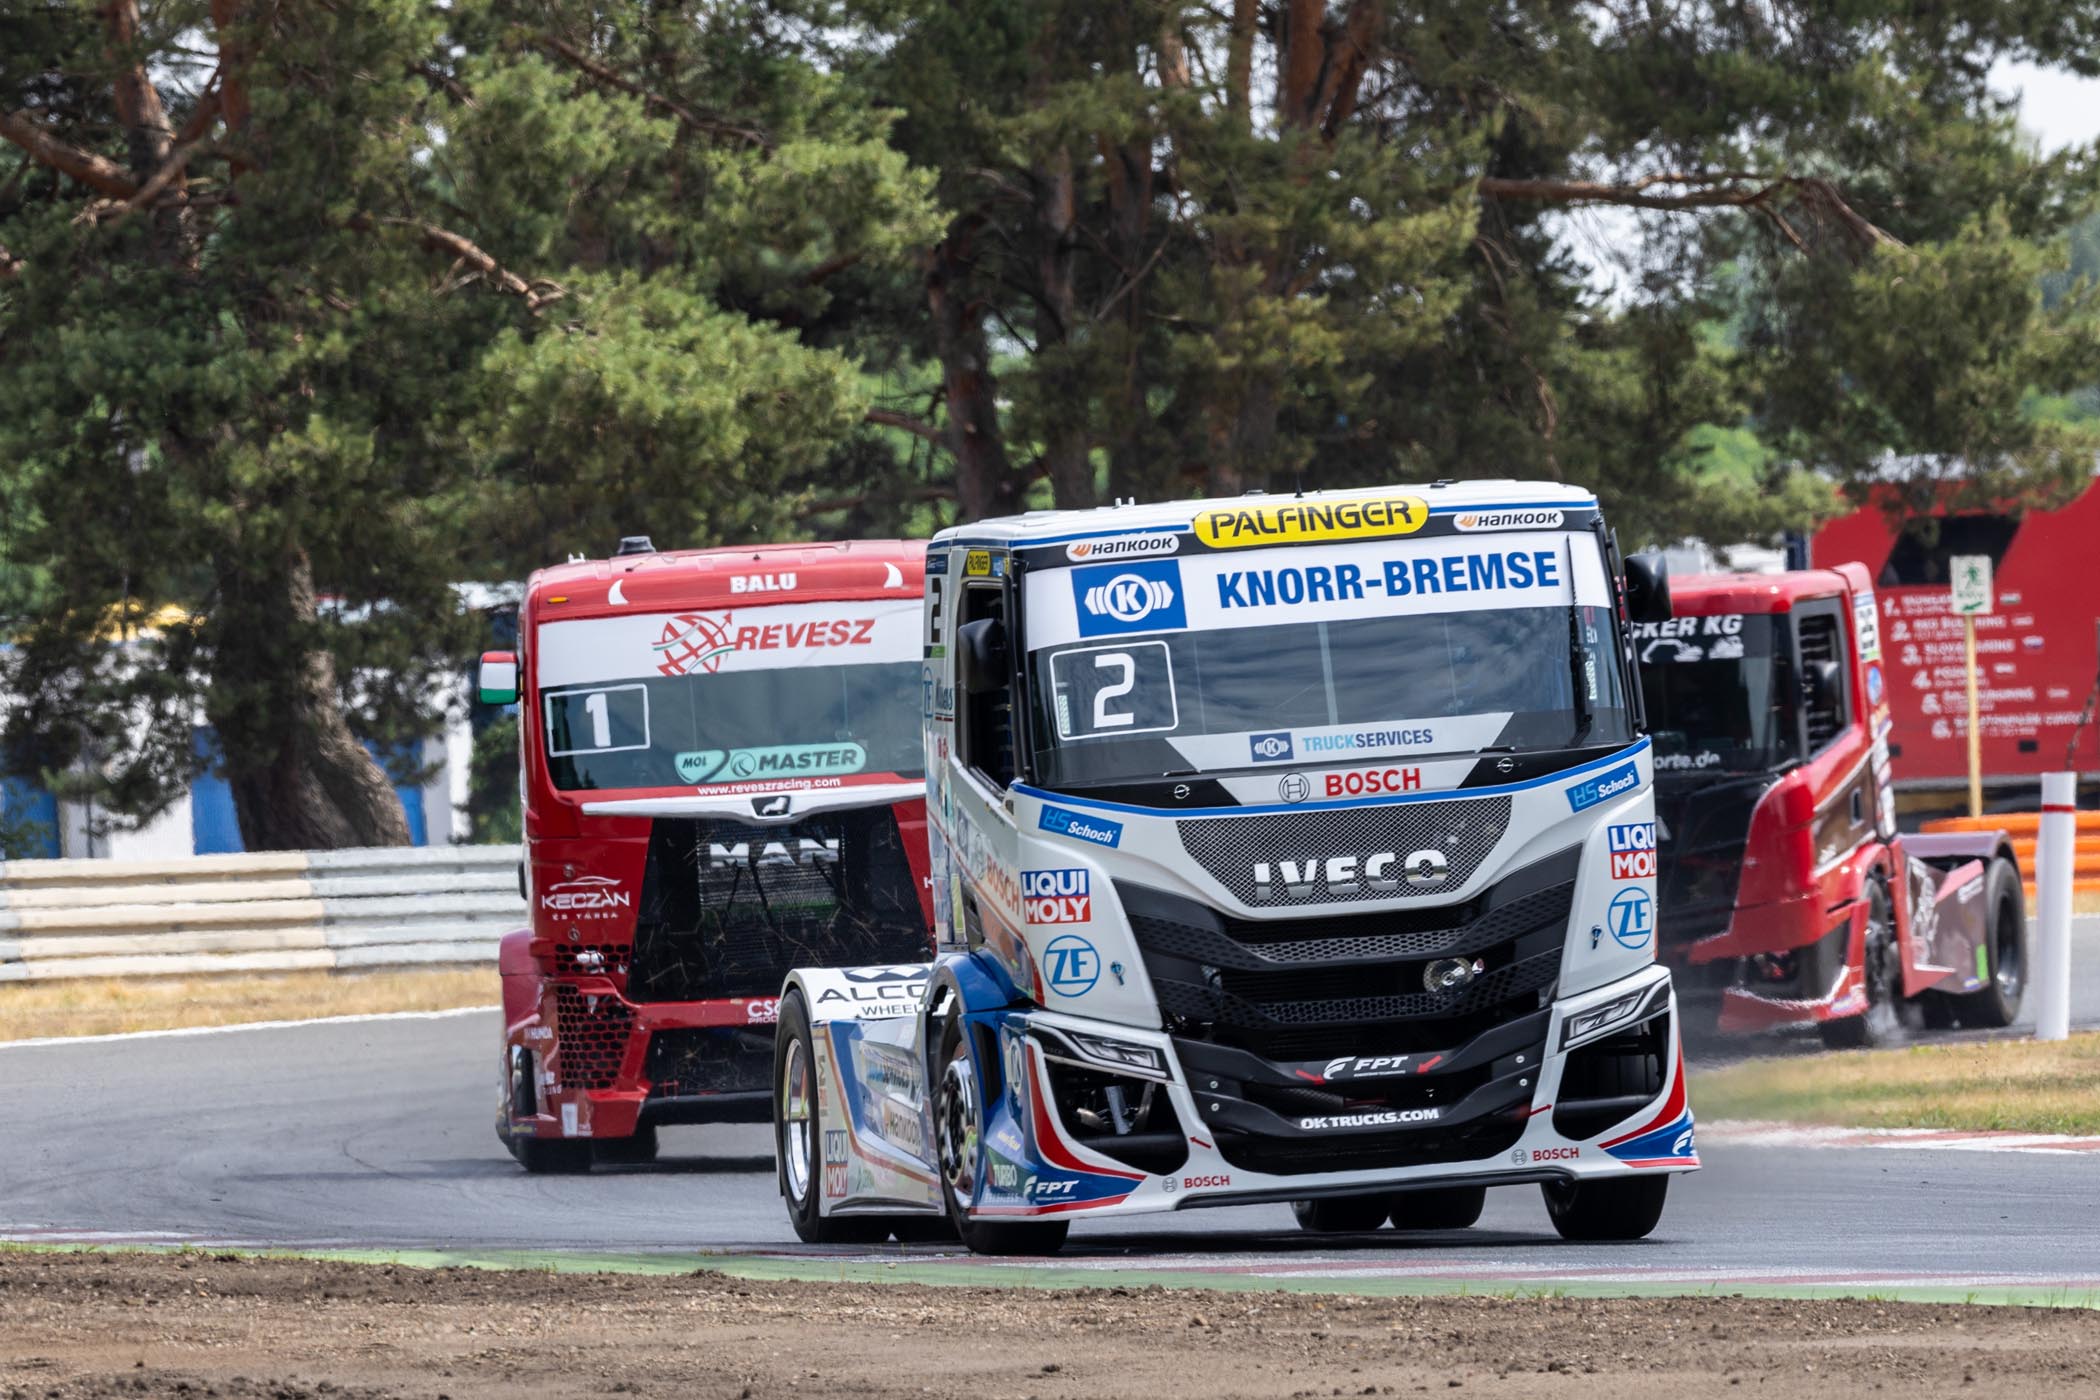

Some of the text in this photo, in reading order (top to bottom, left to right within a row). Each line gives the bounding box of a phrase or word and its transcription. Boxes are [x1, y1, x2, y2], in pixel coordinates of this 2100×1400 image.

[1209, 501, 1414, 539] PALFINGER
[730, 572, 797, 594] BALU
[1217, 551, 1560, 609] KNORR-BREMSE
[735, 618, 876, 651] REVESZ
[1703, 614, 1744, 636] KG
[1093, 652, 1136, 728] 2
[585, 692, 611, 748] 1
[1303, 729, 1433, 751] TRUCKSERVICES
[682, 754, 708, 769] MOL
[758, 749, 858, 771] MASTER
[697, 777, 841, 796] www.reveszracing.com
[1325, 768, 1421, 797] BOSCH
[1598, 773, 1635, 798] Schoch
[1068, 821, 1113, 843] Schoch
[1610, 824, 1656, 851] LIQU
[709, 838, 840, 868] MAN
[1613, 852, 1657, 878] MOL
[1021, 870, 1087, 896] LIQUI
[1254, 849, 1449, 900] IVECO
[1024, 897, 1088, 923] MOLY
[1613, 896, 1652, 939] ZF
[1045, 947, 1095, 985] ZF
[817, 983, 929, 1004] ALCO
[861, 1004, 921, 1017] WHEEL
[1353, 1056, 1409, 1071] FPT
[1301, 1108, 1439, 1129] OK TRUCKS.COM
[1532, 1147, 1579, 1162] BOSCH
[1036, 1180, 1080, 1194] FPT
[1184, 1175, 1231, 1189] BOSCH
